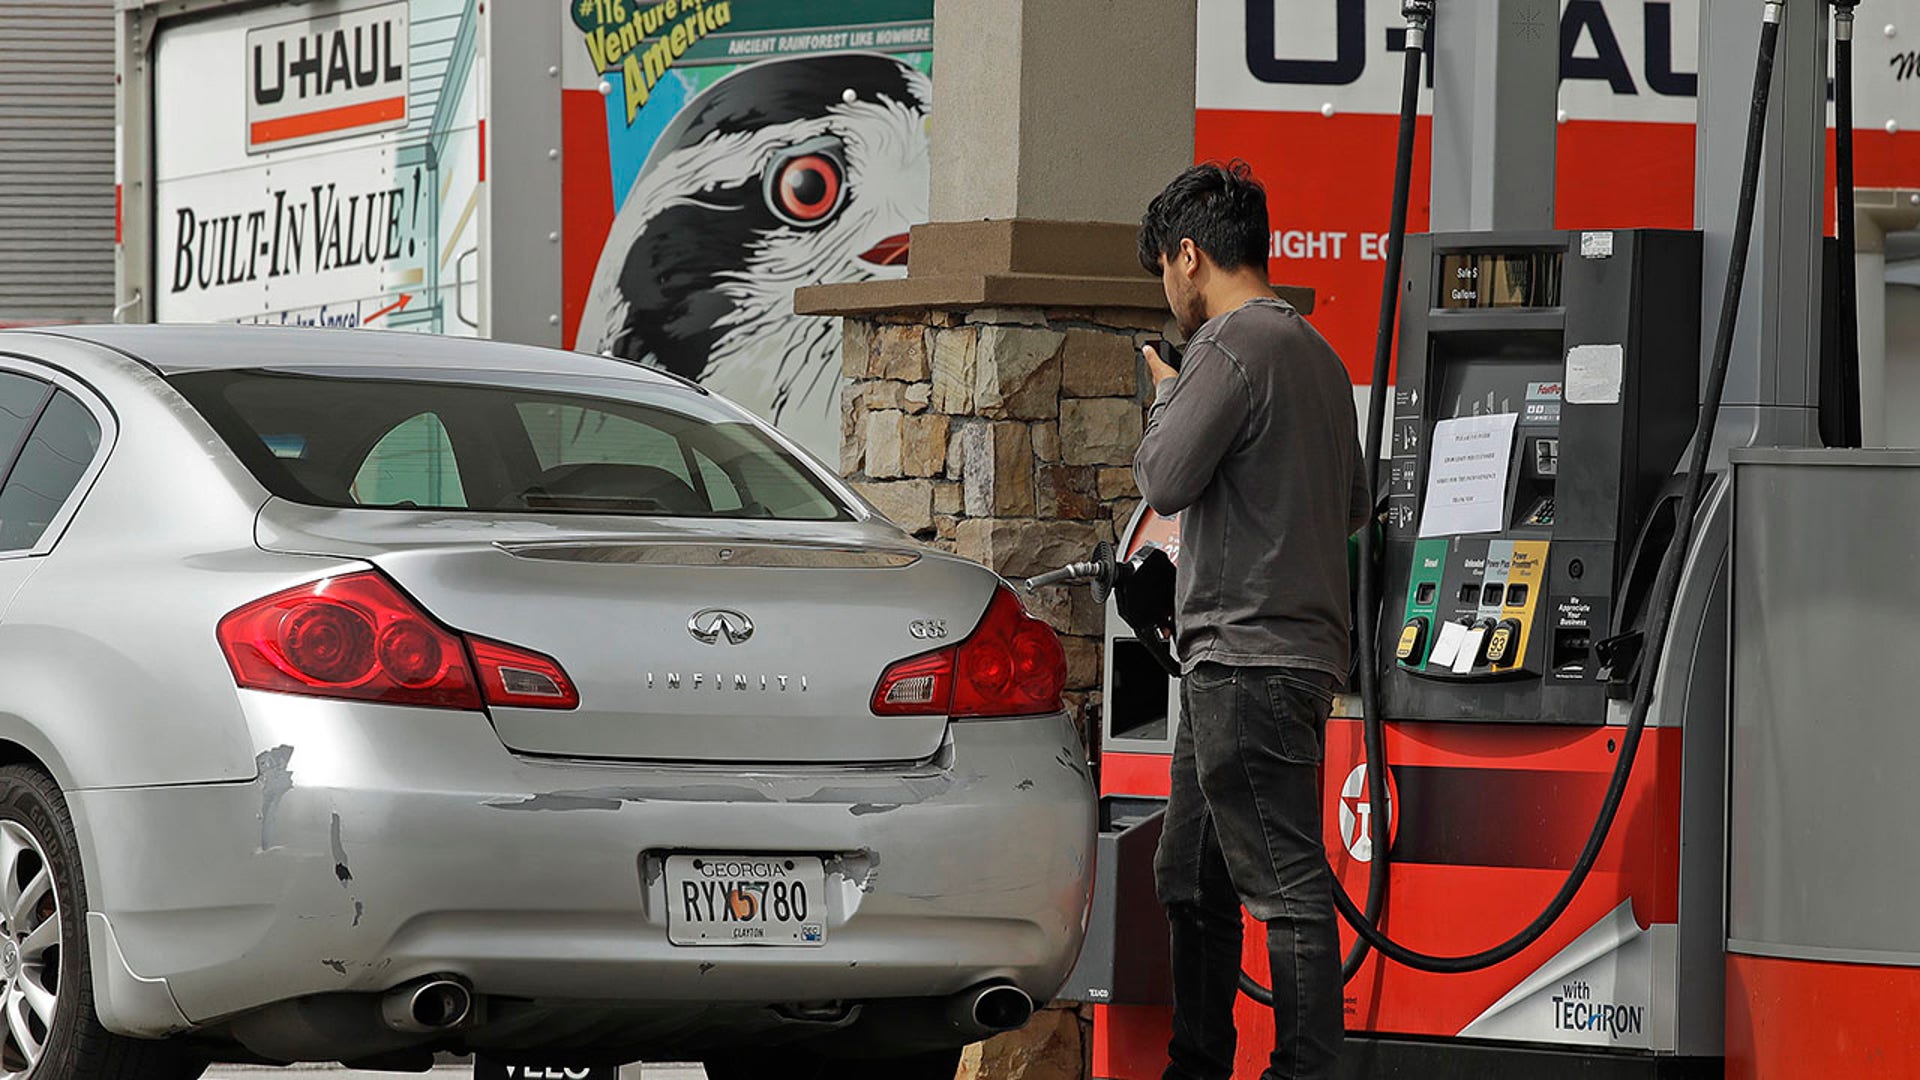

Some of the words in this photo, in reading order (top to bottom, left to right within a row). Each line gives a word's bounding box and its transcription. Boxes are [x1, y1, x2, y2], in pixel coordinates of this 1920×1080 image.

[578, 0, 626, 24] #116
[585, 0, 678, 74] Venture
[728, 37, 776, 55] ANCIENT
[778, 33, 847, 51] RAINFOREST
[849, 31, 874, 47] LIKE
[876, 26, 930, 44] NOWHERE
[253, 19, 403, 105] U-HAUL
[623, 1, 731, 125] America
[1268, 229, 1348, 260] IGHT
[1451, 288, 1477, 300] Gallons
[908, 619, 949, 640] G35
[1490, 637, 1505, 652] 93
[647, 672, 808, 692] INFINITI
[701, 862, 786, 877] GEORGIA
[682, 880, 808, 922] RYX5780
[732, 928, 765, 938] CLAYTON
[1563, 981, 1590, 999] with
[1552, 996, 1642, 1040] TECHRON
